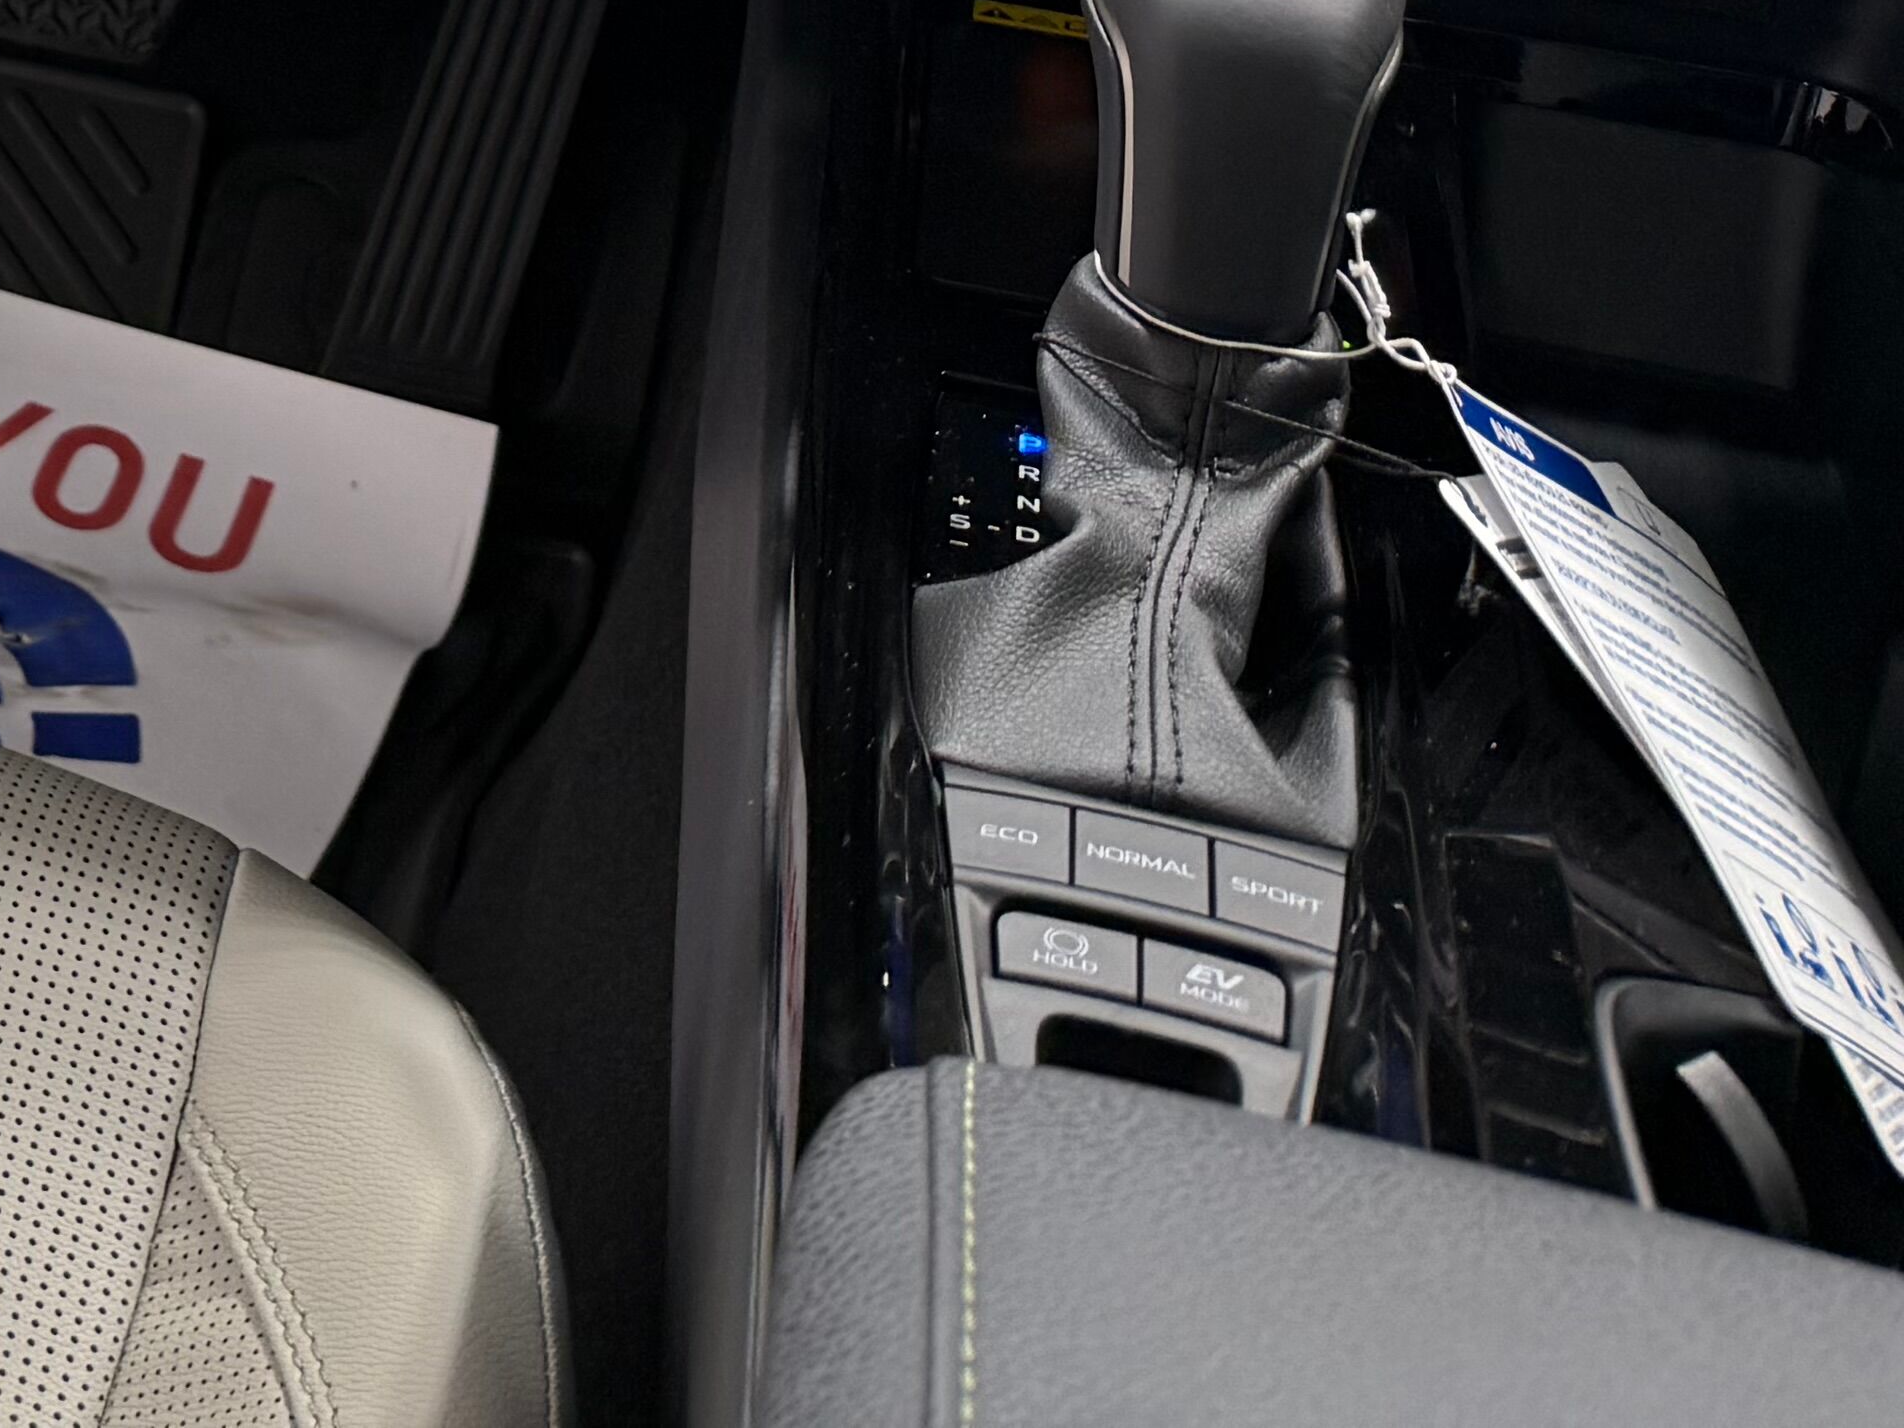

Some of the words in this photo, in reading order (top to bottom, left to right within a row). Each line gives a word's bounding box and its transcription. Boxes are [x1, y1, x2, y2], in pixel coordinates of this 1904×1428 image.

[1018, 464, 1040, 482] R
[1017, 495, 1041, 513] N
[949, 513, 971, 530] S
[1015, 526, 1041, 543] D
[980, 823, 1039, 845] ECO
[1086, 842, 1196, 880] NORMAL
[1230, 875, 1324, 916] SPORT
[1032, 948, 1099, 976] HOLD
[1185, 962, 1244, 990] EV
[1179, 981, 1252, 1013] MODE
